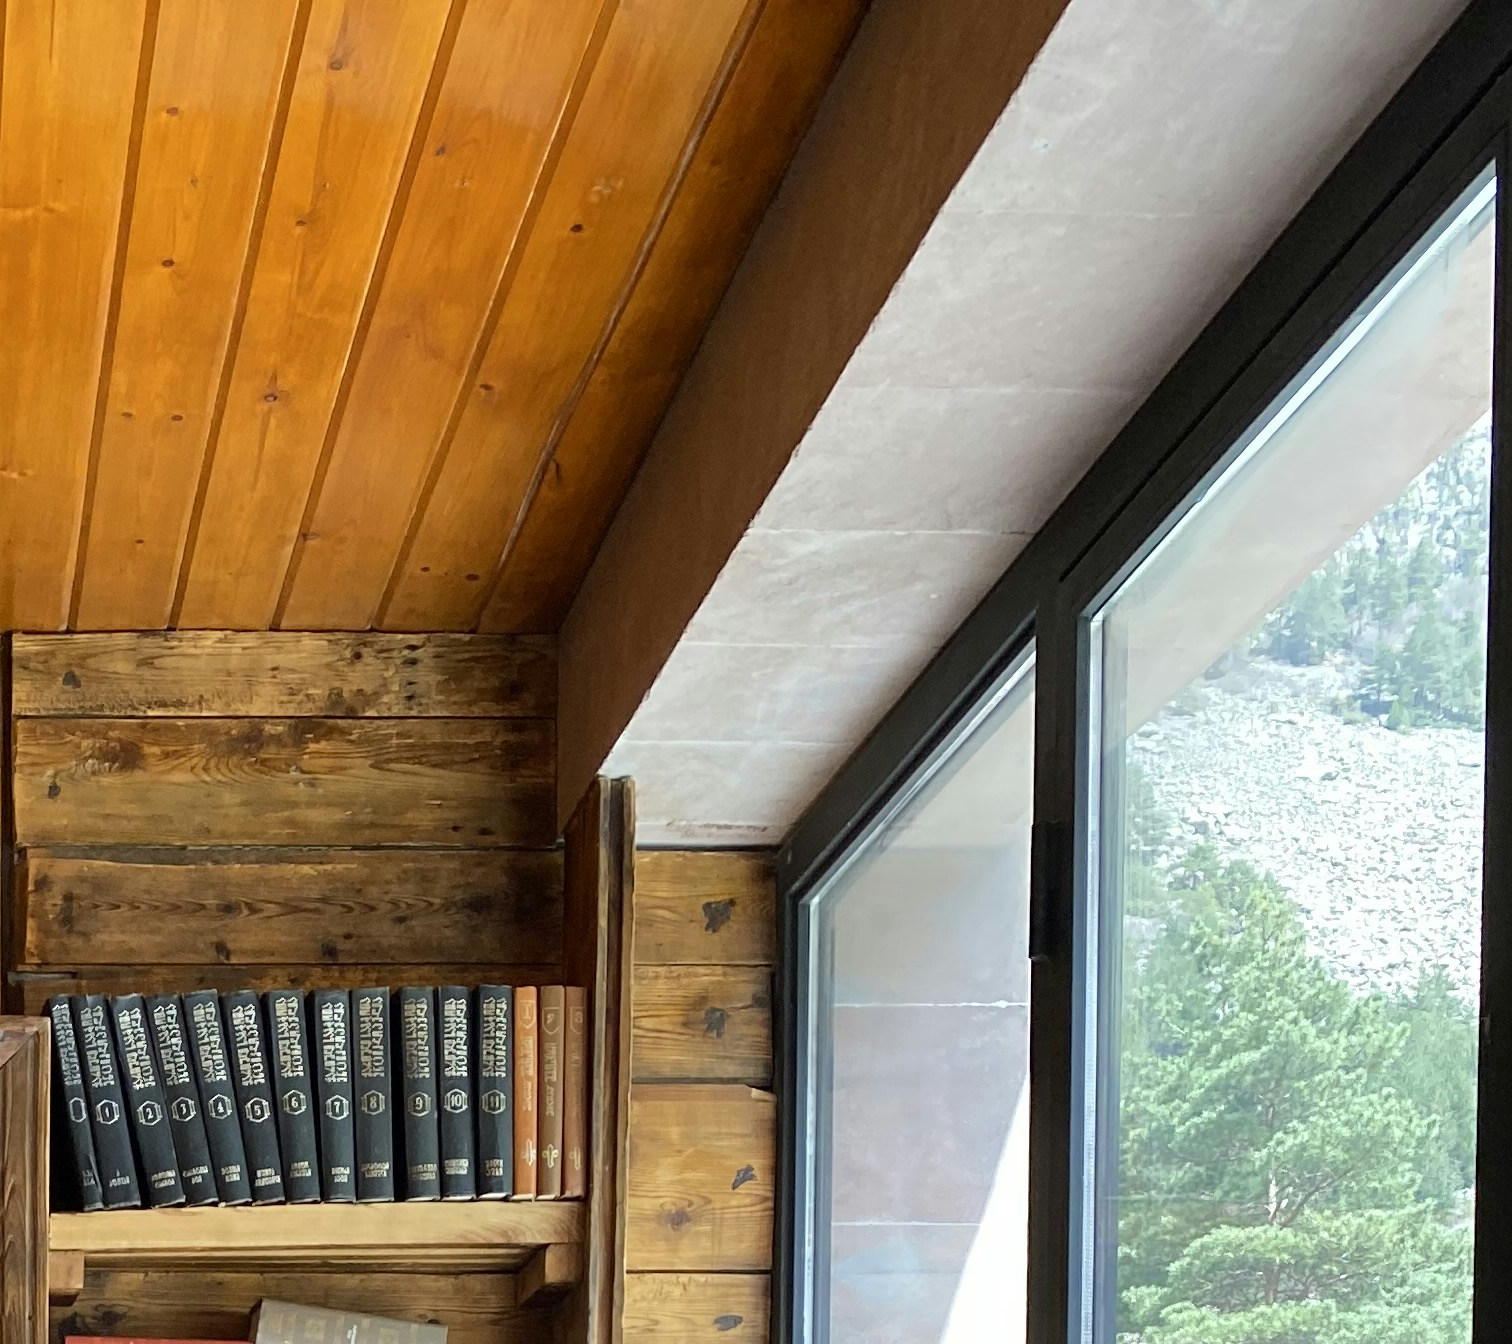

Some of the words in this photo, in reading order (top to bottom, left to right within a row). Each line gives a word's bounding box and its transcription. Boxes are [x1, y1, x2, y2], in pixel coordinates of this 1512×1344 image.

[291, 1097, 297, 1108] 6
[369, 1096, 377, 1108] 8
[414, 1097, 422, 1110] 9
[450, 1095, 462, 1107] 10
[490, 1096, 499, 1107] 11
[180, 1103, 187, 1114] 3
[217, 1102, 225, 1113] 4
[254, 1105, 261, 1116] 5
[333, 1101, 341, 1113] 7
[105, 1108, 111, 1118] 1
[147, 1108, 155, 1120] 2
